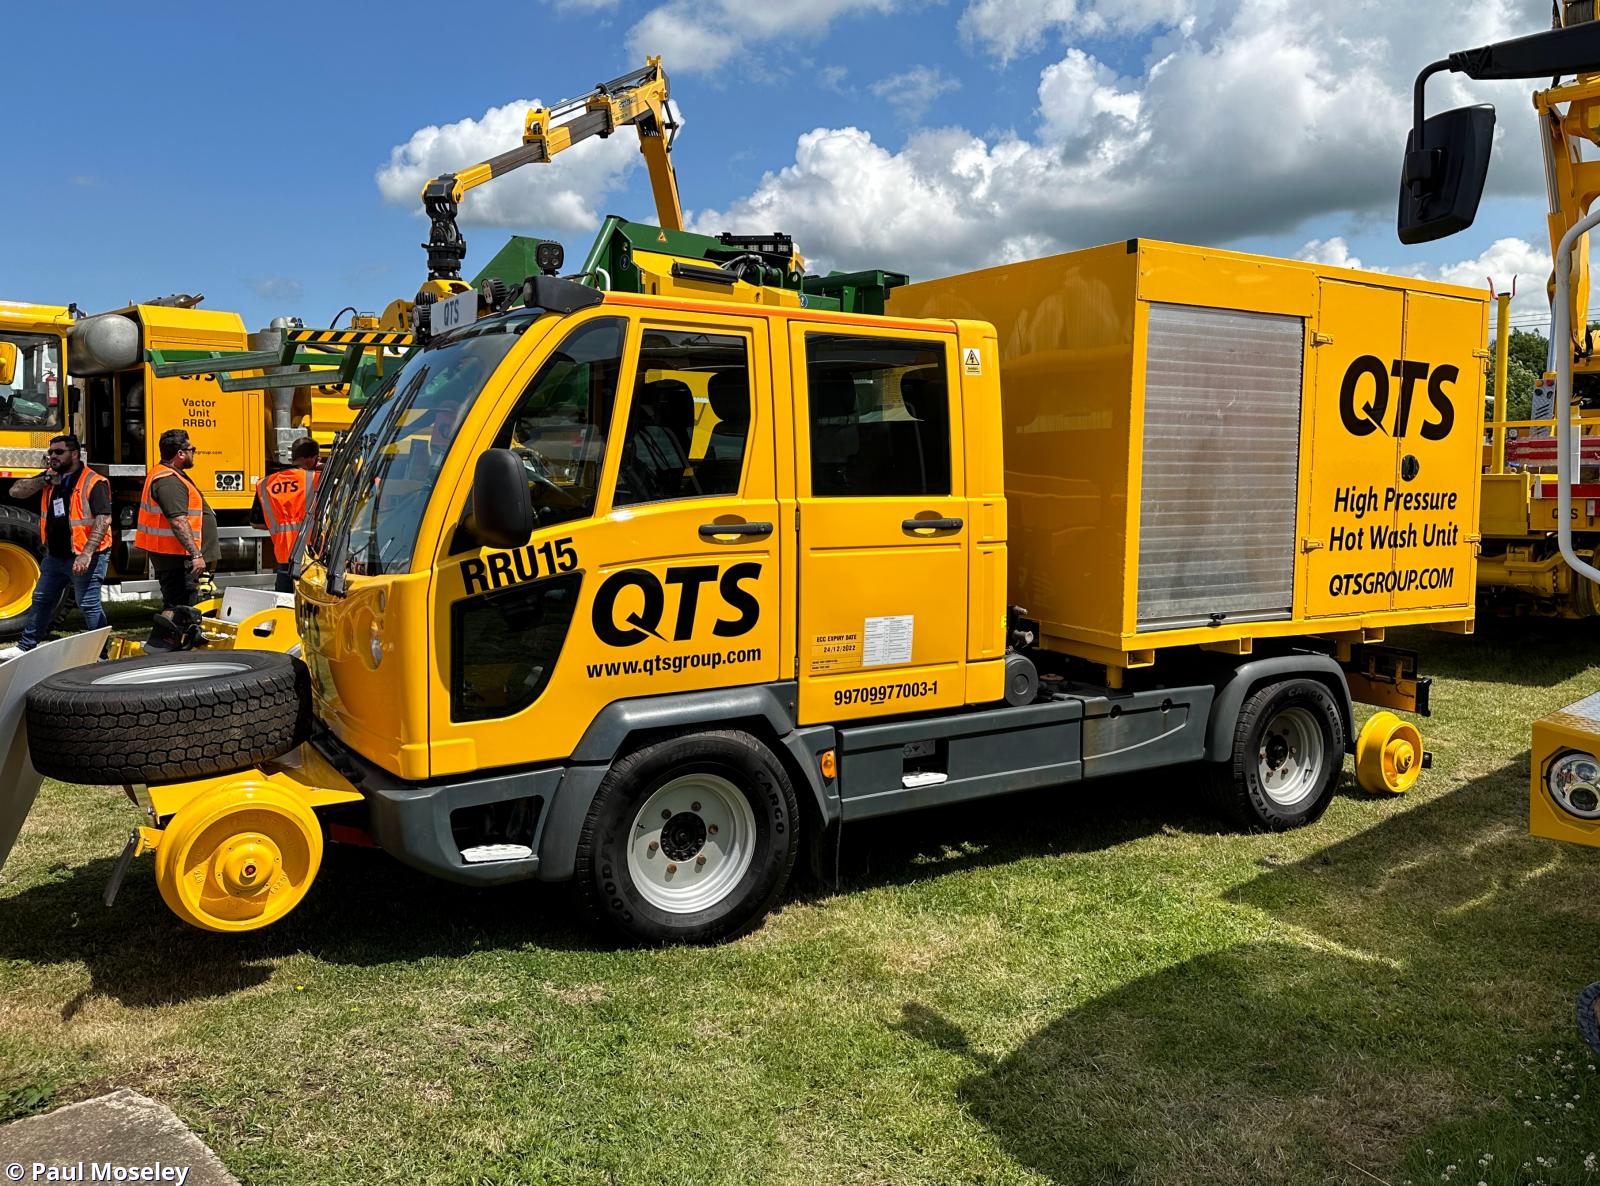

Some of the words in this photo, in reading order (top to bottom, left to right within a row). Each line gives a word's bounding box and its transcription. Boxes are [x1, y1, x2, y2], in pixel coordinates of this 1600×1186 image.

[444, 299, 460, 326] QTS
[182, 398, 216, 407] Vactor
[188, 408, 210, 417] Unit
[1339, 354, 1460, 441] QTS
[182, 419, 217, 428] RRB01
[271, 480, 299, 495] QTS
[1333, 485, 1379, 519] High
[1383, 487, 1458, 511] Pressure
[1329, 526, 1365, 552] Hot
[1370, 522, 1418, 550] Wash
[1422, 521, 1459, 547] Unit
[459, 536, 578, 596] RRU15
[1328, 567, 1455, 597] QTSGROUP.COM
[591, 562, 763, 648] QTS
[586, 648, 762, 679] www.qtsgroup.com
[833, 680, 938, 706] 99709977003-1
[1288, 688, 1324, 702] CAGO
[754, 770, 785, 835] CARGO
